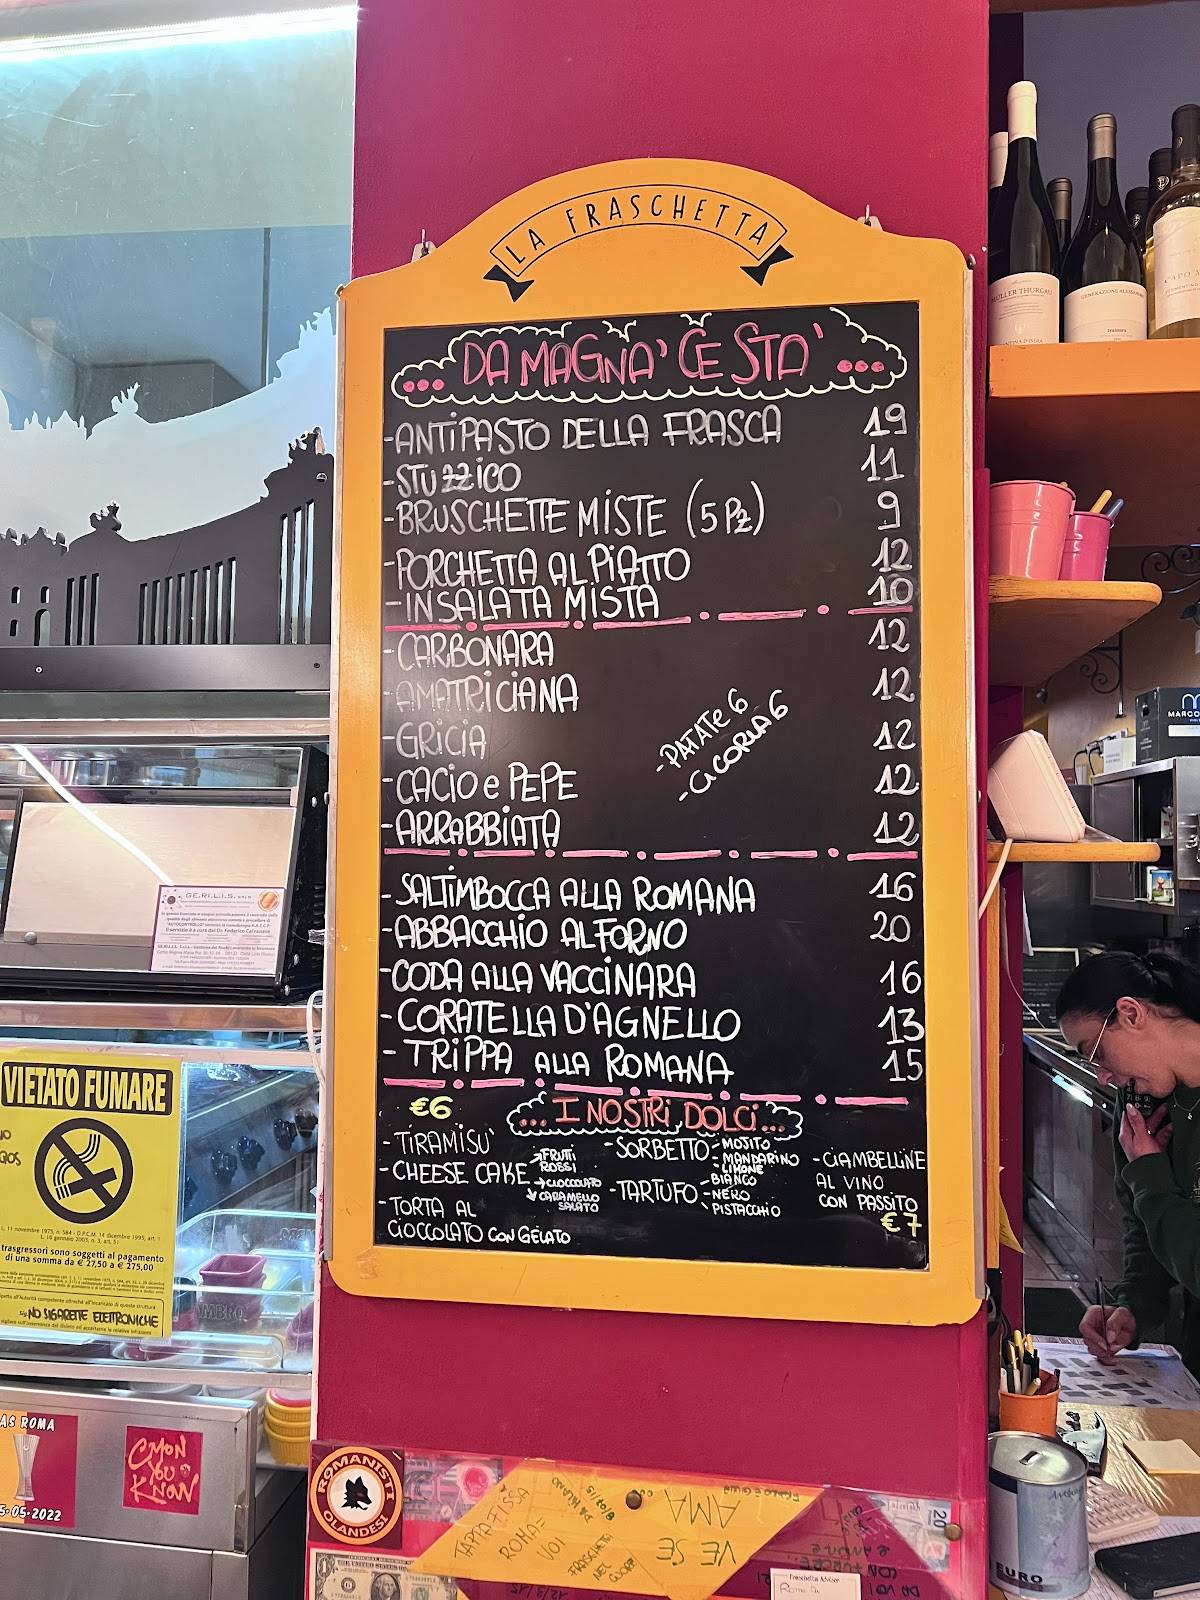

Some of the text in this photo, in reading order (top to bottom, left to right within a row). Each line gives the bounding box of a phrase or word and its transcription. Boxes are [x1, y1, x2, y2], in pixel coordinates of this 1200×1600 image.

[507, 194, 770, 264] LA FRASCHETTA
[462, 338, 510, 386] DA
[678, 328, 722, 379] CE
[395, 403, 908, 455] ANTIPASTO DELLA FRASCA 19
[861, 444, 905, 482] 11
[396, 496, 571, 536] BRUSCHETTE
[578, 488, 667, 537] MISTE
[877, 490, 901, 531] 9
[396, 548, 538, 591] PORCHETTA
[549, 551, 589, 588] AL
[871, 537, 913, 573] 12
[407, 575, 914, 623] INSALATA MISTA 10
[398, 618, 911, 671] CARBONARA 12
[871, 666, 916, 702] 12
[727, 688, 749, 714] 6
[768, 689, 789, 720] 6
[873, 718, 916, 751] 12
[508, 761, 579, 803] PEPE
[874, 763, 920, 796] 12
[395, 805, 920, 849] ARRABBIATA 12
[395, 865, 917, 917] SALTIMBOCCA ALLA ROMANA 16
[394, 913, 549, 950] ABBACCHIO
[869, 911, 912, 943] 20
[391, 956, 922, 1001] CODA ALLA VACCINARA 16
[397, 998, 926, 1046] CORATELLA D'AGNELLO 13
[402, 1034, 924, 1085] TRIPPA ALLA ROMANA 15
[3, 1066, 167, 1112] VIETATO FUMARE
[408, 1095, 454, 1120] €6
[551, 1096, 581, 1123] I
[615, 1136, 771, 1162] SORBETTO MOJITO
[391, 1159, 469, 1185] CHEESE
[474, 1161, 531, 1186] CAKE
[616, 1172, 758, 1205] TARTUFO BIANCO
[815, 1174, 884, 1191] AL VINO
[388, 1196, 478, 1219] TORTA AL
[538, 1190, 600, 1203] CARAMELLO
[557, 1201, 600, 1213] SALATO
[711, 1188, 751, 1202] NERO
[818, 1194, 849, 1210] CON
[517, 1225, 572, 1245] GELATO
[1, 1244, 164, 1263] trasgressori sono soggetti al pagamento
[5, 1253, 13, 1261] di
[33, 1257, 62, 1265] somma
[64, 1258, 75, 1266] da
[77, 1259, 84, 1267] €
[86, 1260, 107, 1269] 27,50
[117, 1261, 124, 1269] €
[126, 1262, 154, 1271] 275,00
[28, 1306, 42, 1320] NO
[0, 1413, 56, 1432] AS ROMA
[128, 1434, 187, 1471] CMON
[130, 1472, 200, 1506] KNOW
[148, 1460, 176, 1486] YOU
[317, 1453, 396, 1502] ROMANISTI
[322, 1509, 390, 1539] OLANDESI
[664, 1488, 742, 1529] AMA
[933, 1509, 947, 1528] 20
[995, 1561, 1044, 1584] EURO
